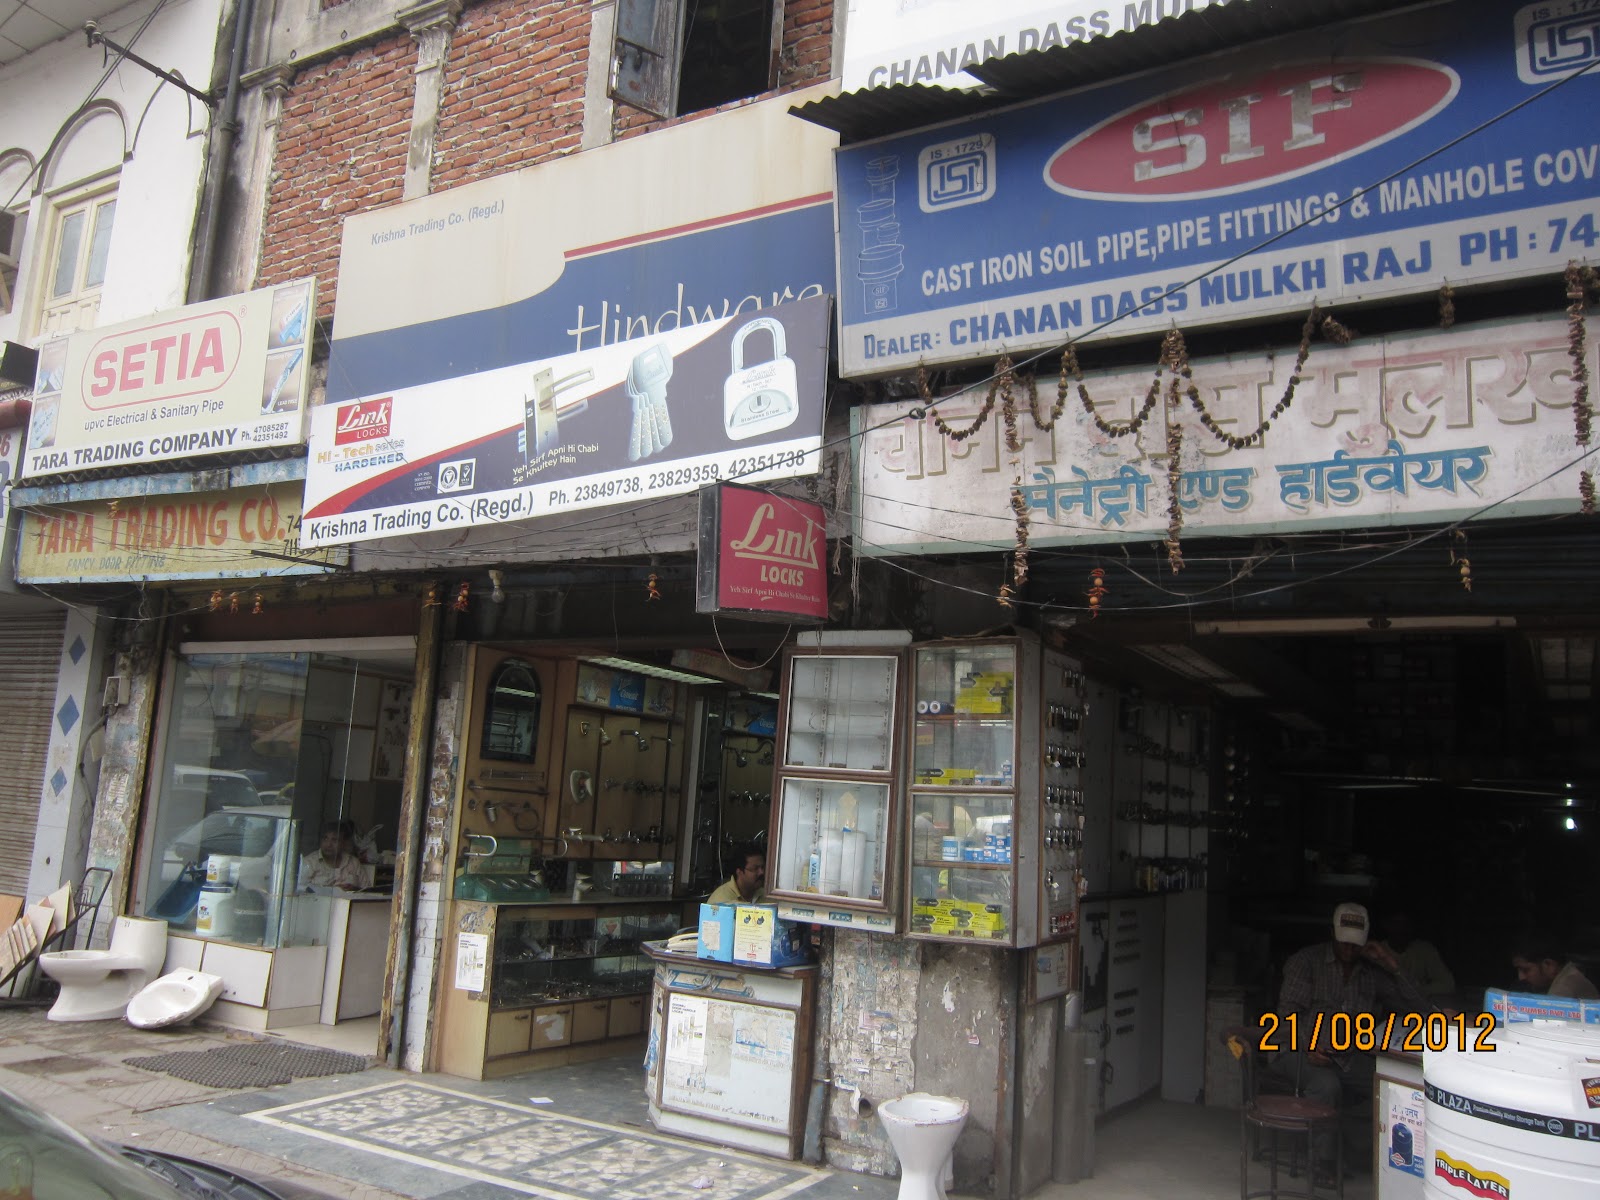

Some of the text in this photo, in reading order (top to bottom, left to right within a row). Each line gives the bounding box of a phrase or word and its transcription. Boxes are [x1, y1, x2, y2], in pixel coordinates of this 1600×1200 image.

[867, 36, 1005, 91] CHANAN
[1018, 9, 1110, 55] DASS
[1132, 71, 1364, 182] SIF
[930, 149, 943, 159] IS
[371, 199, 505, 245] Krishna Trading Co. (Regd.)
[922, 262, 974, 296] CAST
[981, 250, 1033, 286] IRON
[1039, 244, 1091, 273] SOIL
[1219, 191, 1340, 243] FITTINGS
[1350, 187, 1370, 219] &
[1379, 158, 1524, 214] MANHOLE
[1534, 144, 1600, 187] COV
[950, 299, 1083, 346] CHANAN
[1092, 282, 1188, 319] DASS
[1200, 258, 1326, 307] MULKH
[1342, 240, 1432, 285] RAJ
[91, 327, 225, 398] SETIA
[107, 409, 148, 428] Electrical
[151, 408, 157, 419] &
[160, 401, 199, 422] Sanitary
[201, 399, 224, 415] Pipe
[338, 402, 389, 430] Link
[356, 426, 388, 439] LOCKS
[32, 454, 69, 471] TARA
[73, 440, 144, 465] TRADING
[149, 428, 238, 455] COMPANY
[335, 452, 404, 472] HARDENED
[513, 443, 599, 475] Yeh Sirf Apni Hi Chabi
[513, 455, 577, 485] Se Khultey Hain
[310, 518, 367, 540] Krishna
[372, 508, 431, 533] Trading
[437, 503, 464, 523] Co.
[470, 491, 534, 523] (Regd.)
[549, 491, 570, 506] Ph.
[728, 449, 805, 476] 42351738
[36, 512, 94, 555] TARA
[109, 500, 228, 550] TRADING
[730, 503, 819, 565] Link
[99, 556, 122, 570] DOOR
[760, 565, 804, 587] LOCKS
[1520, 1006, 1547, 1015] PUMPS
[1437, 1090, 1473, 1114] PLAZA
[1516, 1114, 1534, 1126] Storage
[1534, 1118, 1546, 1127] Tank
[1435, 1158, 1469, 1179] TRIPLE
[1467, 1172, 1507, 1198] LAYER
